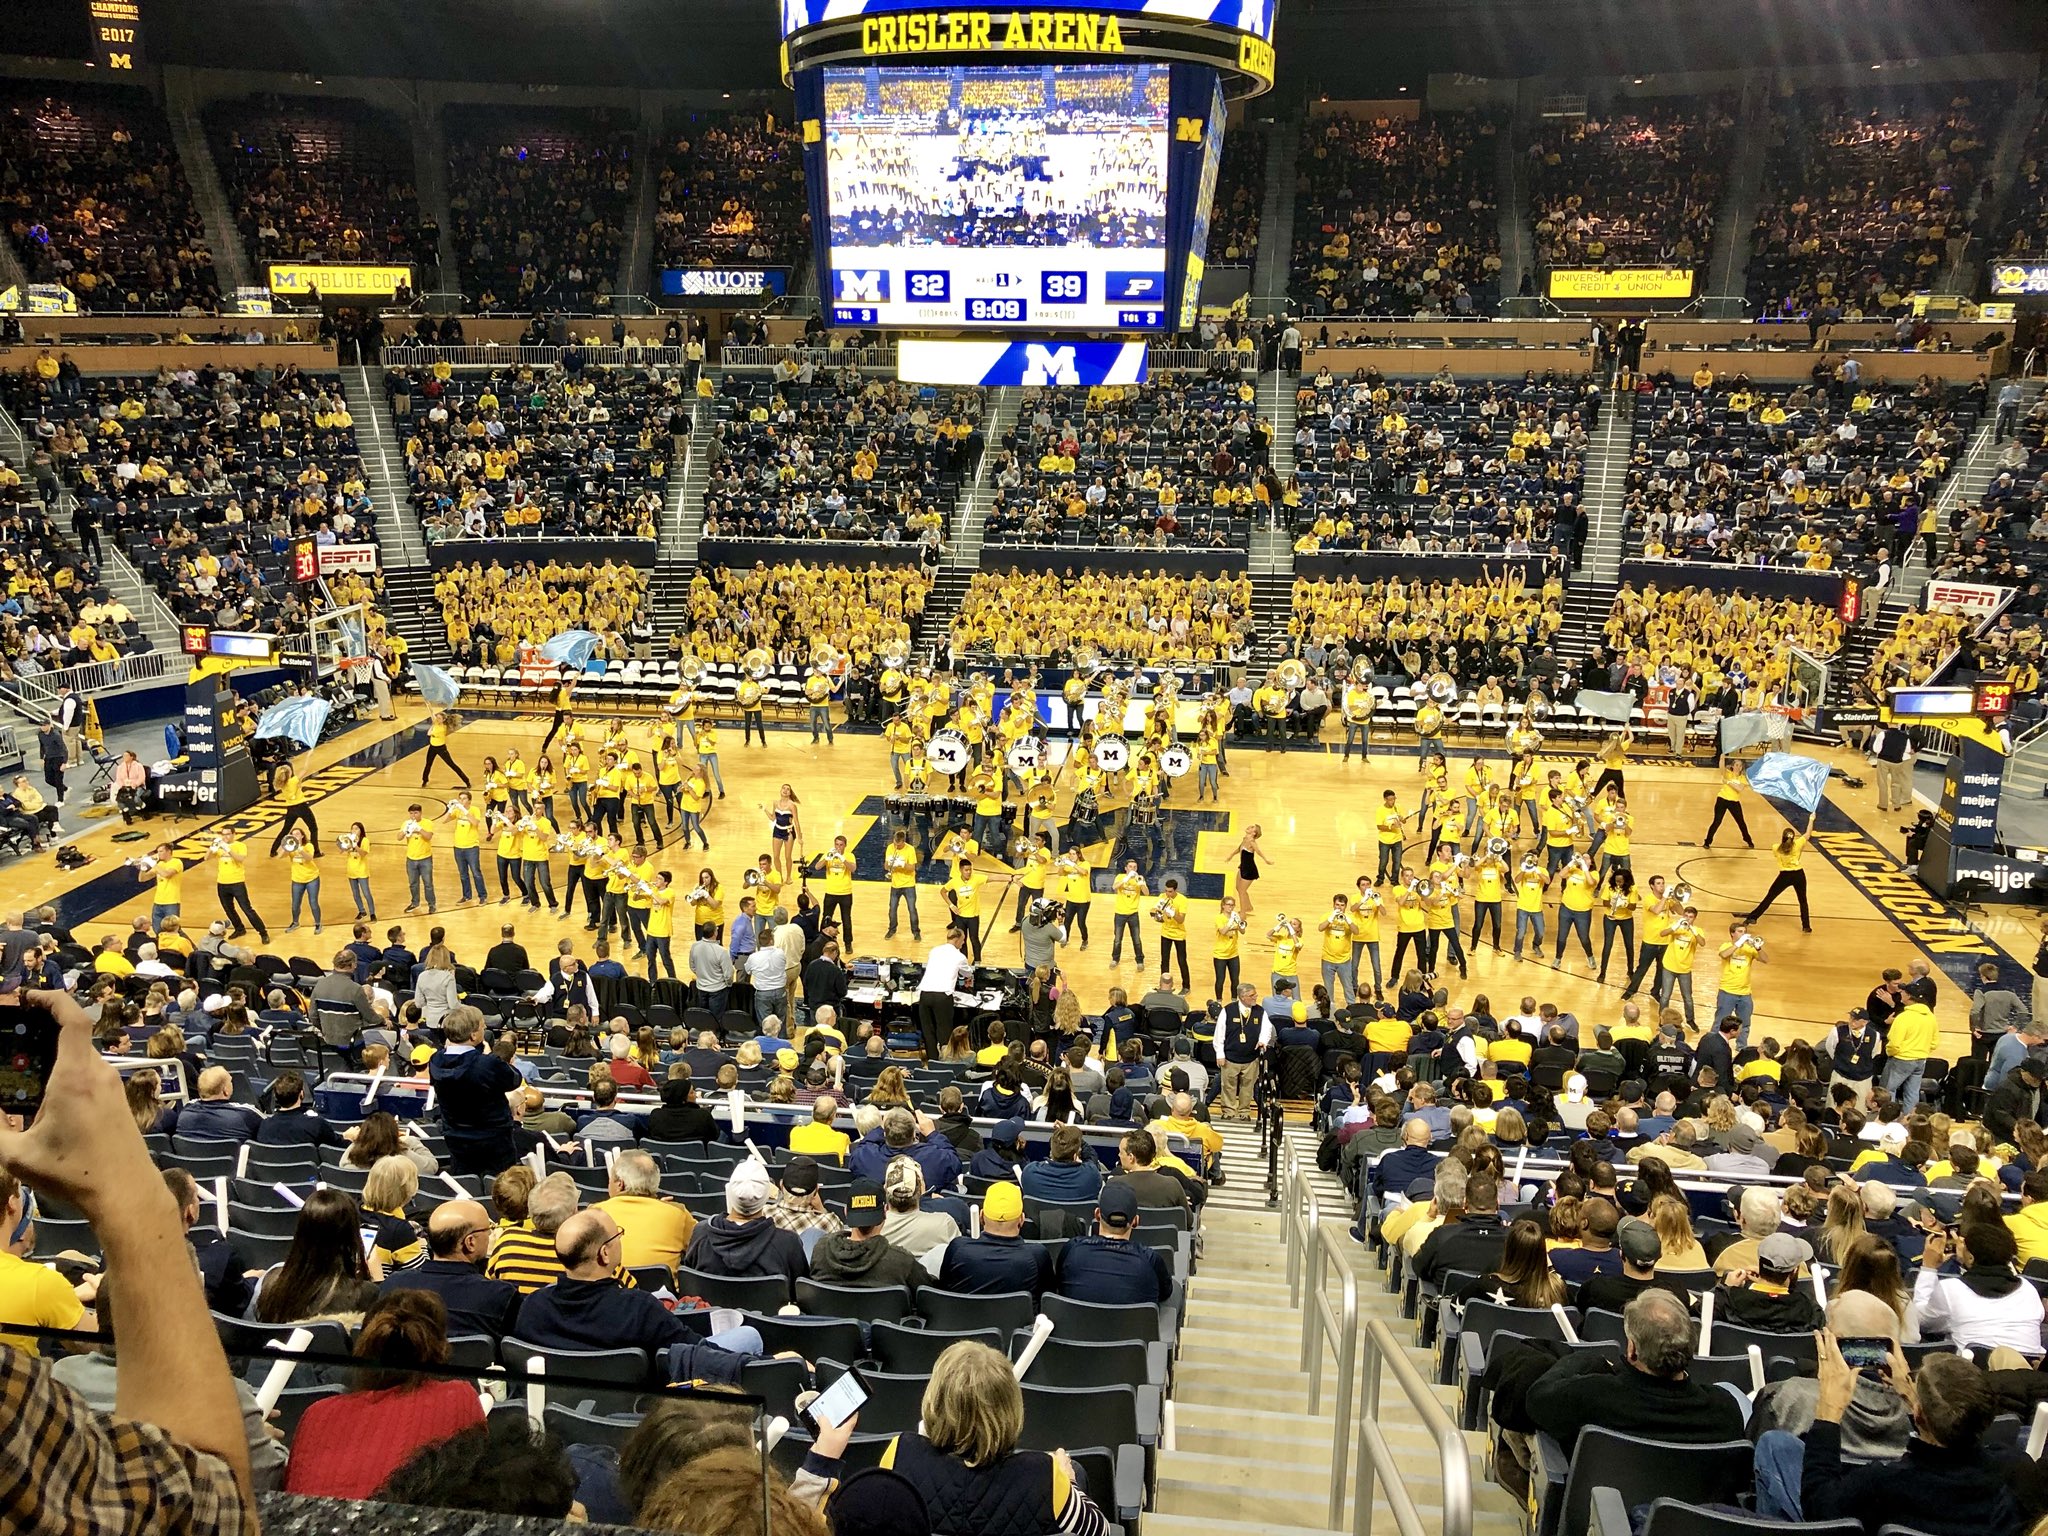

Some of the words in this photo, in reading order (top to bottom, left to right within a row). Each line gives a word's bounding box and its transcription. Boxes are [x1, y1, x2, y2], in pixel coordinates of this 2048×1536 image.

[91, 2, 139, 14] CHAMPIONS
[101, 27, 134, 42] 2017
[862, 12, 991, 55] CRISLER
[1003, 12, 1124, 53] ARENA
[110, 53, 132, 69] M
[802, 119, 821, 143] M
[1176, 117, 1203, 142] M
[703, 271, 764, 287] RUOFF
[998, 273, 1007, 286] 1
[1554, 273, 1615, 282] UNIVERSITY
[1620, 273, 1632, 282] OF
[1636, 272, 1690, 282] MICHIGAN
[704, 287, 724, 295] HOME
[840, 270, 881, 301] M
[911, 274, 944, 296] 32
[1047, 275, 1081, 297] 39
[1124, 279, 1154, 295] P
[1573, 282, 1611, 291] CREDIT
[1628, 282, 1662, 291] UNION
[837, 310, 852, 319] TOL
[971, 300, 1020, 319] 9:09
[1123, 313, 1139, 323] TOL
[1021, 343, 1080, 385] M
[321, 550, 371, 564] ESPN
[297, 555, 314, 579] 30
[1933, 587, 1995, 607] ESPN
[187, 627, 206, 637] 9:09
[189, 638, 202, 650] 30
[1985, 685, 2010, 695] 9:09
[1983, 696, 2002, 710] 30
[186, 705, 211, 717] meijer
[221, 709, 236, 727] M
[187, 723, 213, 735] meijer
[189, 741, 214, 753] meijer
[938, 748, 956, 761] M
[1018, 756, 1034, 766] M
[1103, 750, 1118, 760] M
[1169, 758, 1182, 767] M
[1963, 773, 1999, 787] meijer
[1945, 778, 1957, 798] M
[1961, 795, 1997, 808] meijer
[1958, 816, 1994, 829] meijer
[1956, 865, 2035, 893] meijer
[1810, 831, 1998, 956] MICHIGAN
